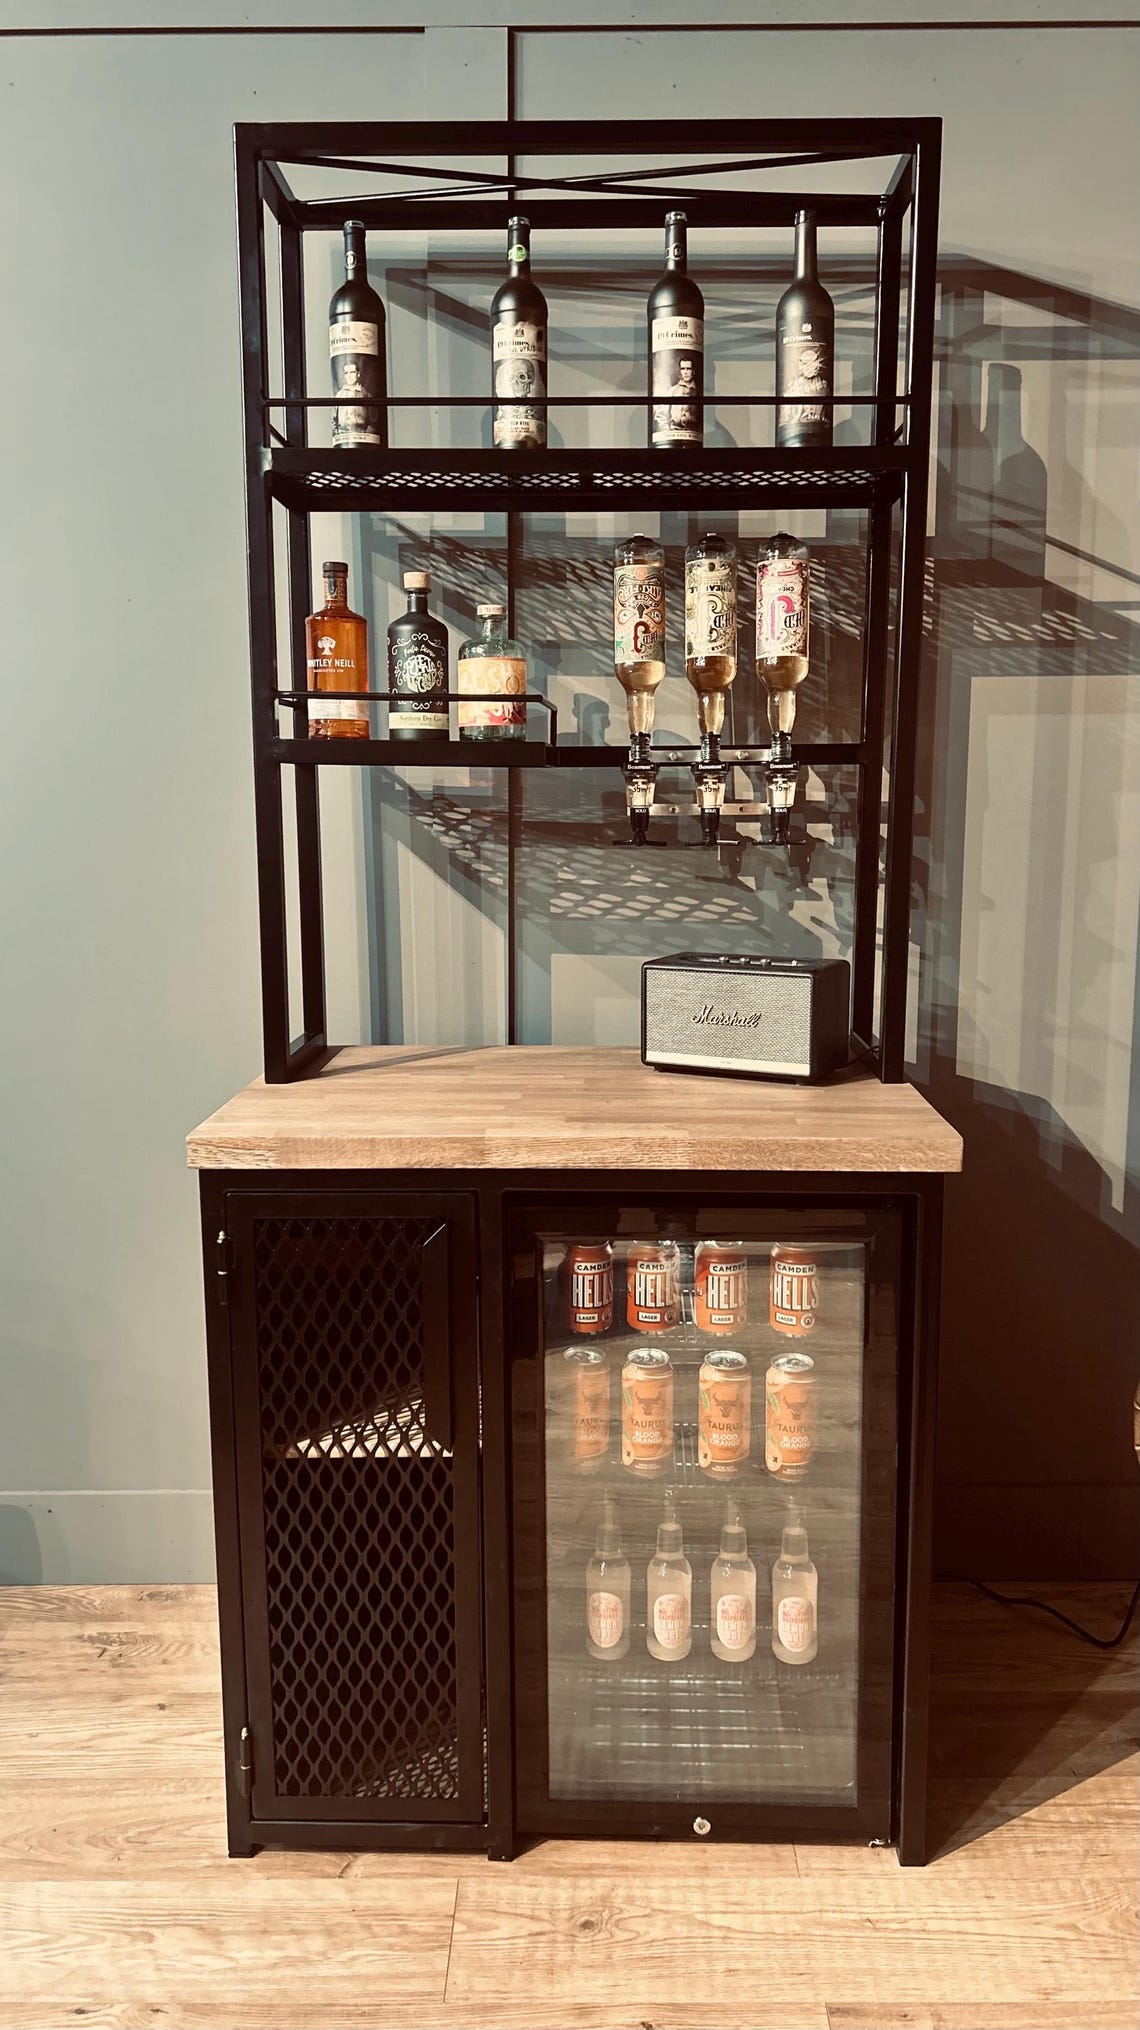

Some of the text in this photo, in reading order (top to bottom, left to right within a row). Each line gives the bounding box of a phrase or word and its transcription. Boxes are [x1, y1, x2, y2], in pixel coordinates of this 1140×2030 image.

[334, 659, 356, 668] NEILL
[691, 1005, 761, 1028] Marshall
[776, 1263, 814, 1273] CAMDEN
[773, 1272, 818, 1310] HELLS
[782, 1435, 808, 1443] BLOOD
